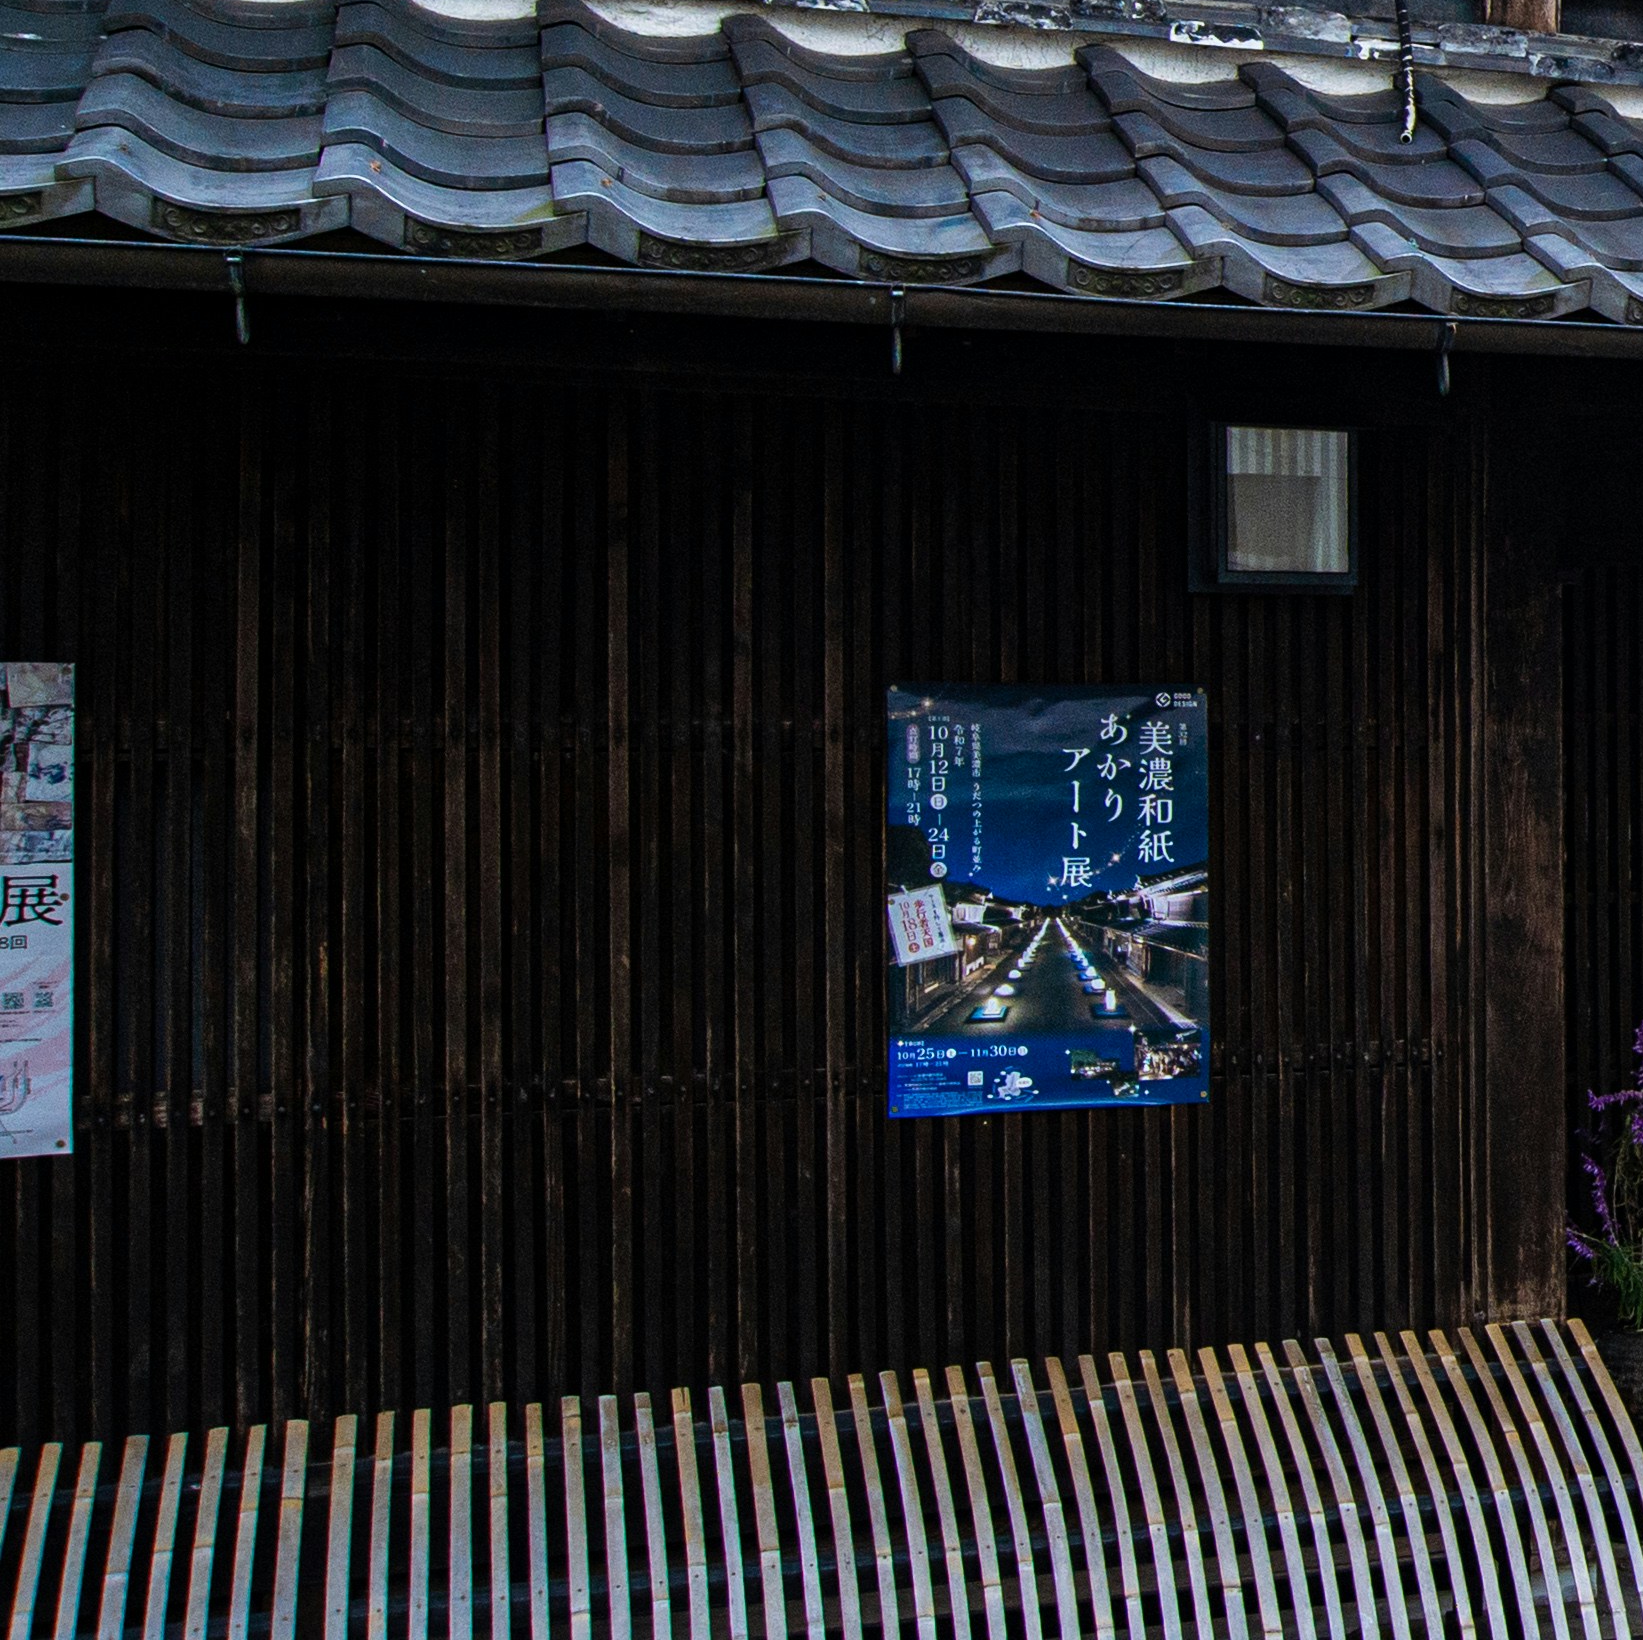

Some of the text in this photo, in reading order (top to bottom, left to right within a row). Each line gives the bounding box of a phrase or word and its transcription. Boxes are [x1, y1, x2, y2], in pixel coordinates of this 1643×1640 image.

[953, 723, 965, 768] 令和7年
[1096, 713, 1132, 823] あかり
[1137, 720, 1175, 863] 美濃和紙
[1060, 747, 1093, 888] アート展
[0, 874, 63, 926] 展
